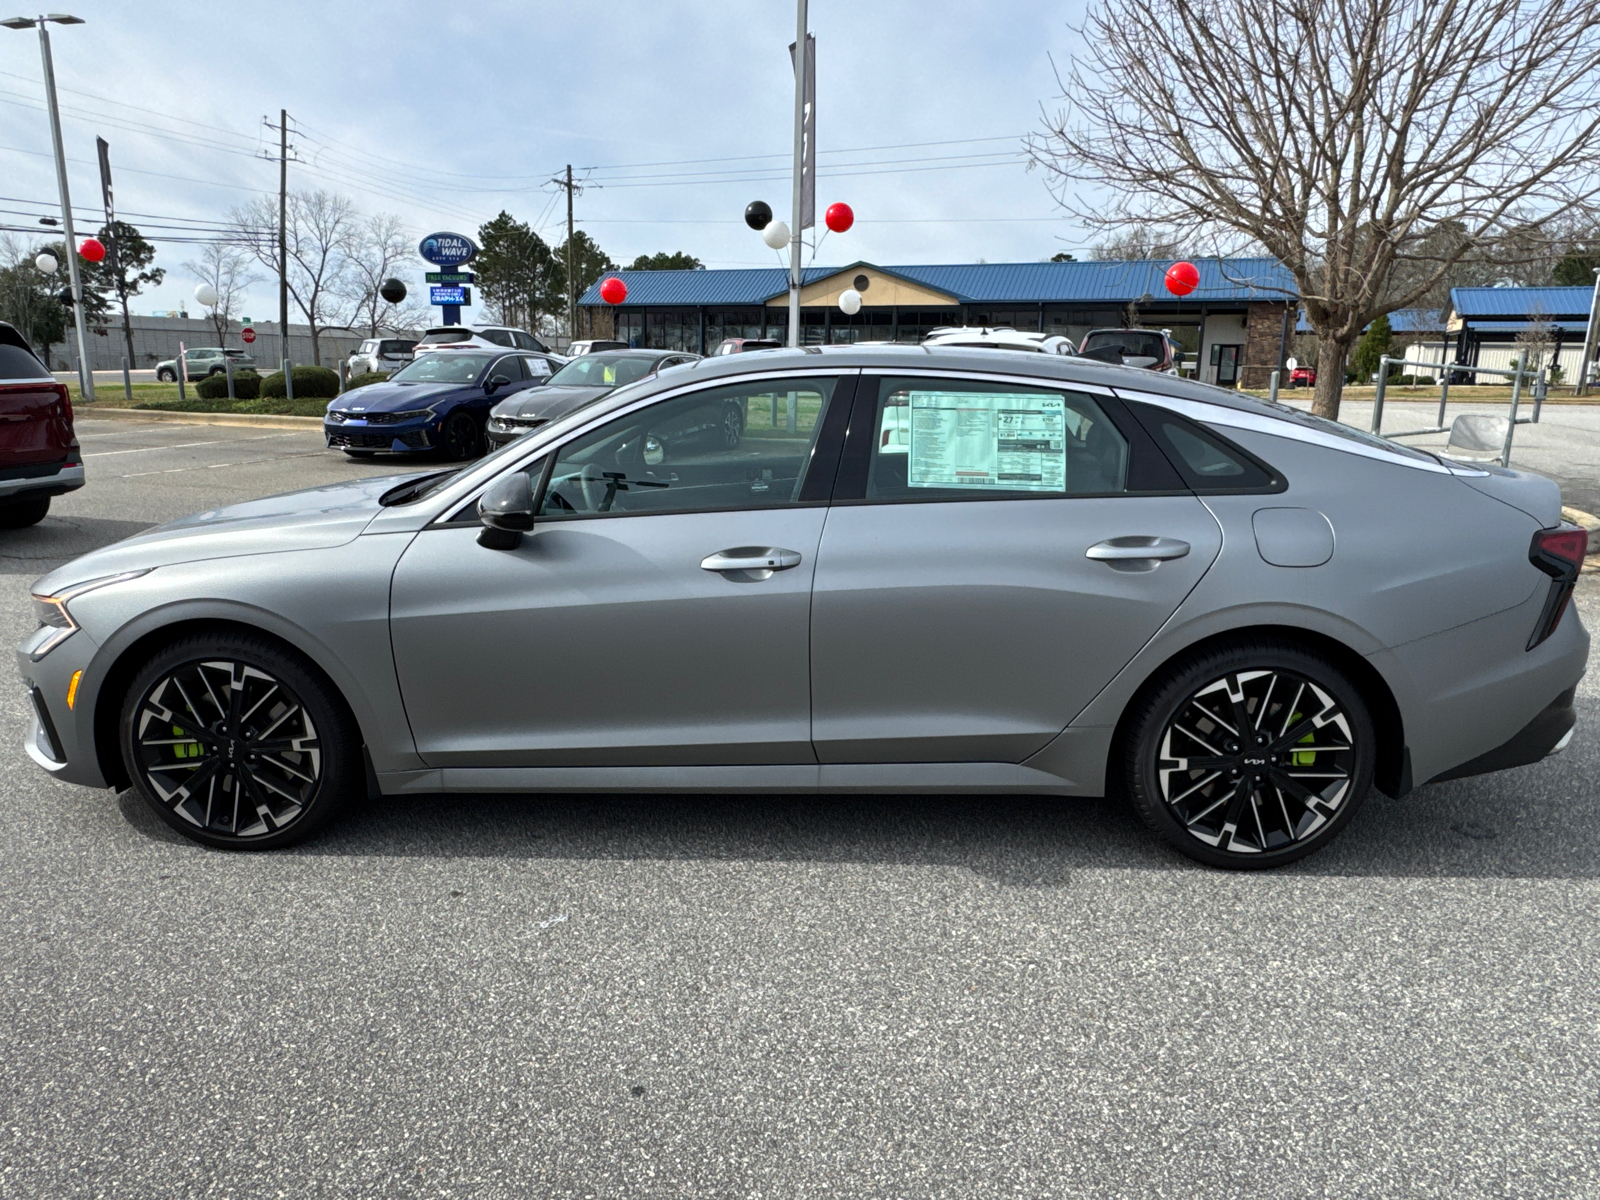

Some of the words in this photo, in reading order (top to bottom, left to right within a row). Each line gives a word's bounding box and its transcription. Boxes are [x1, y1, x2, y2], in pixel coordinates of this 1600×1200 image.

[437, 238, 463, 248] TIDAL
[441, 247, 468, 256] WAVE
[1003, 416, 1014, 424] 27
